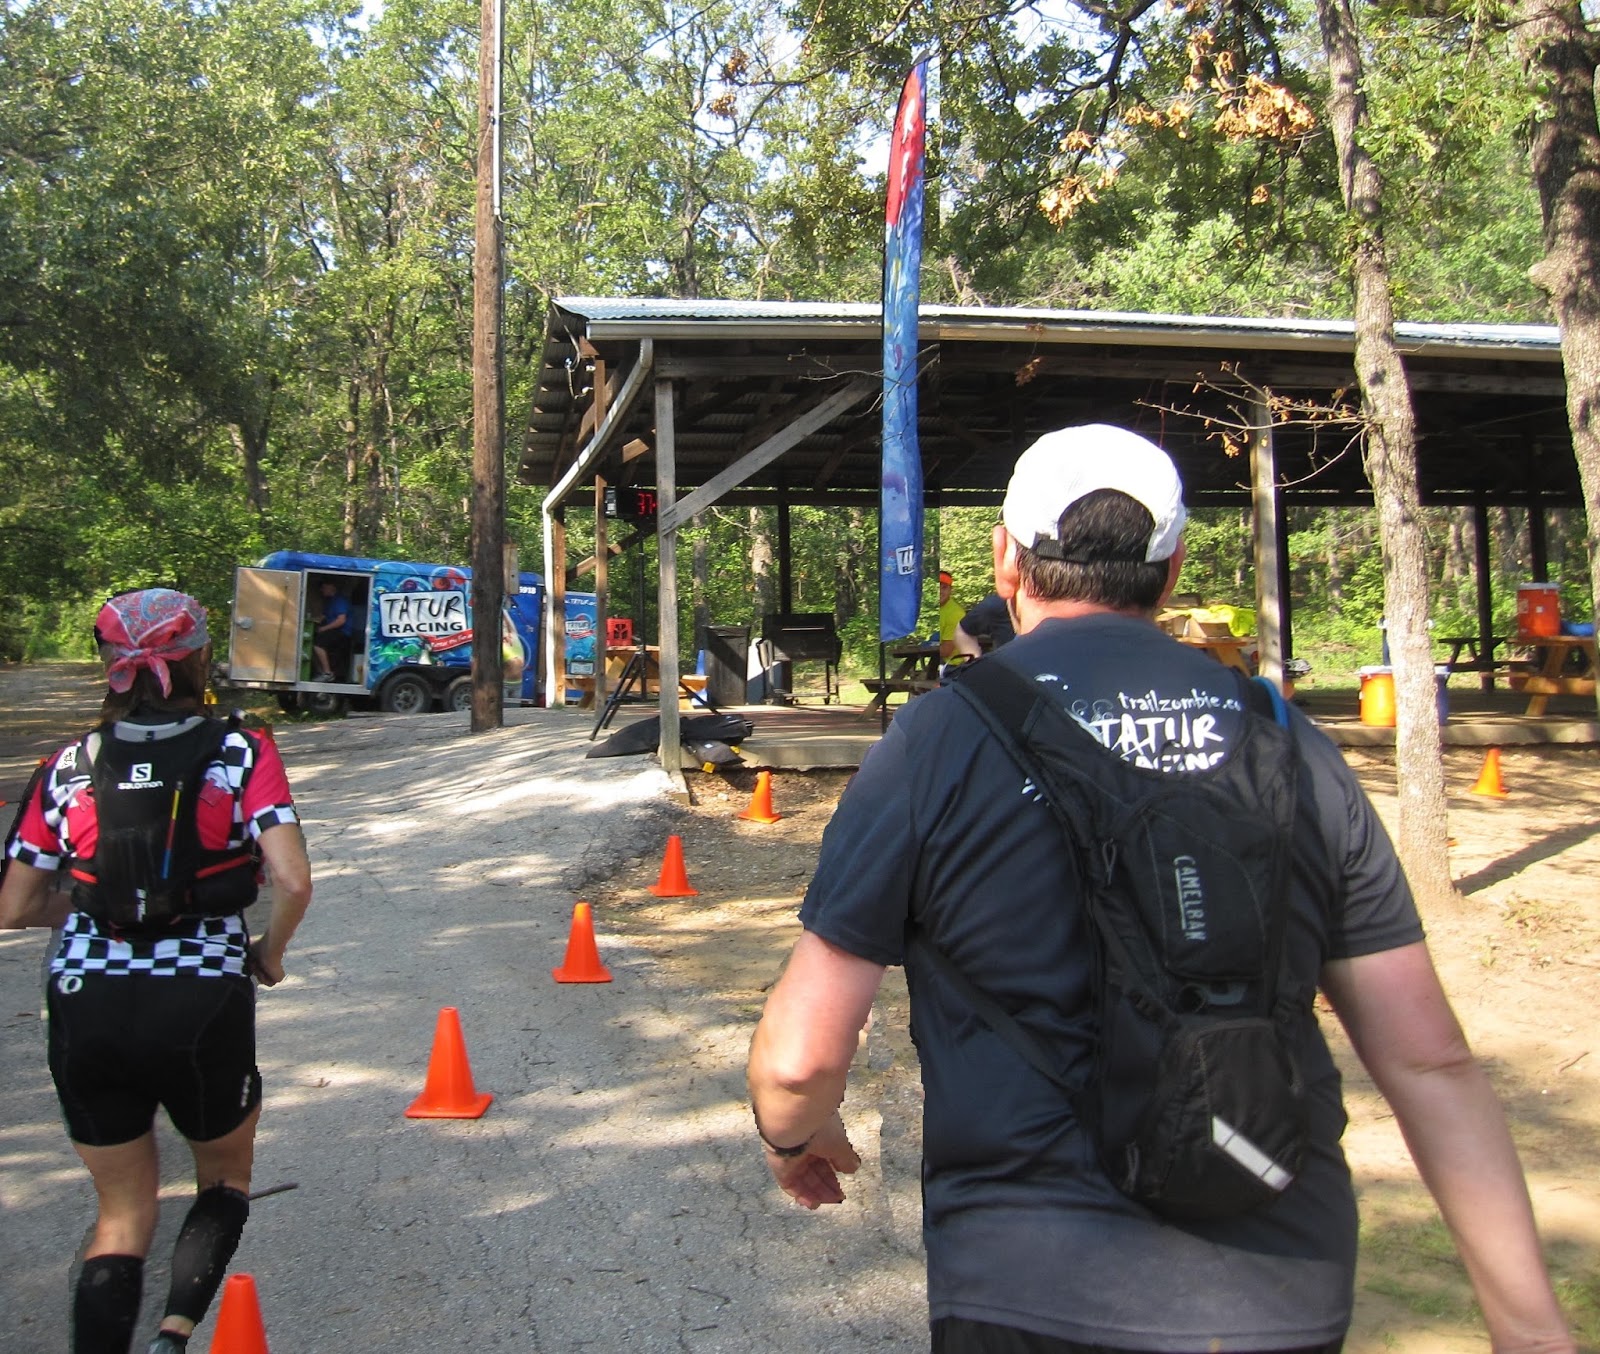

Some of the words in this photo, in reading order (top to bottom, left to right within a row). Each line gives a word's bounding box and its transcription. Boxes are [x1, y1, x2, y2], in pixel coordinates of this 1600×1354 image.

[384, 595, 463, 621] TATUR
[389, 621, 463, 633] RACING
[1089, 712, 1224, 757] TATUR
[1174, 855, 1206, 941] CAMELBAK
